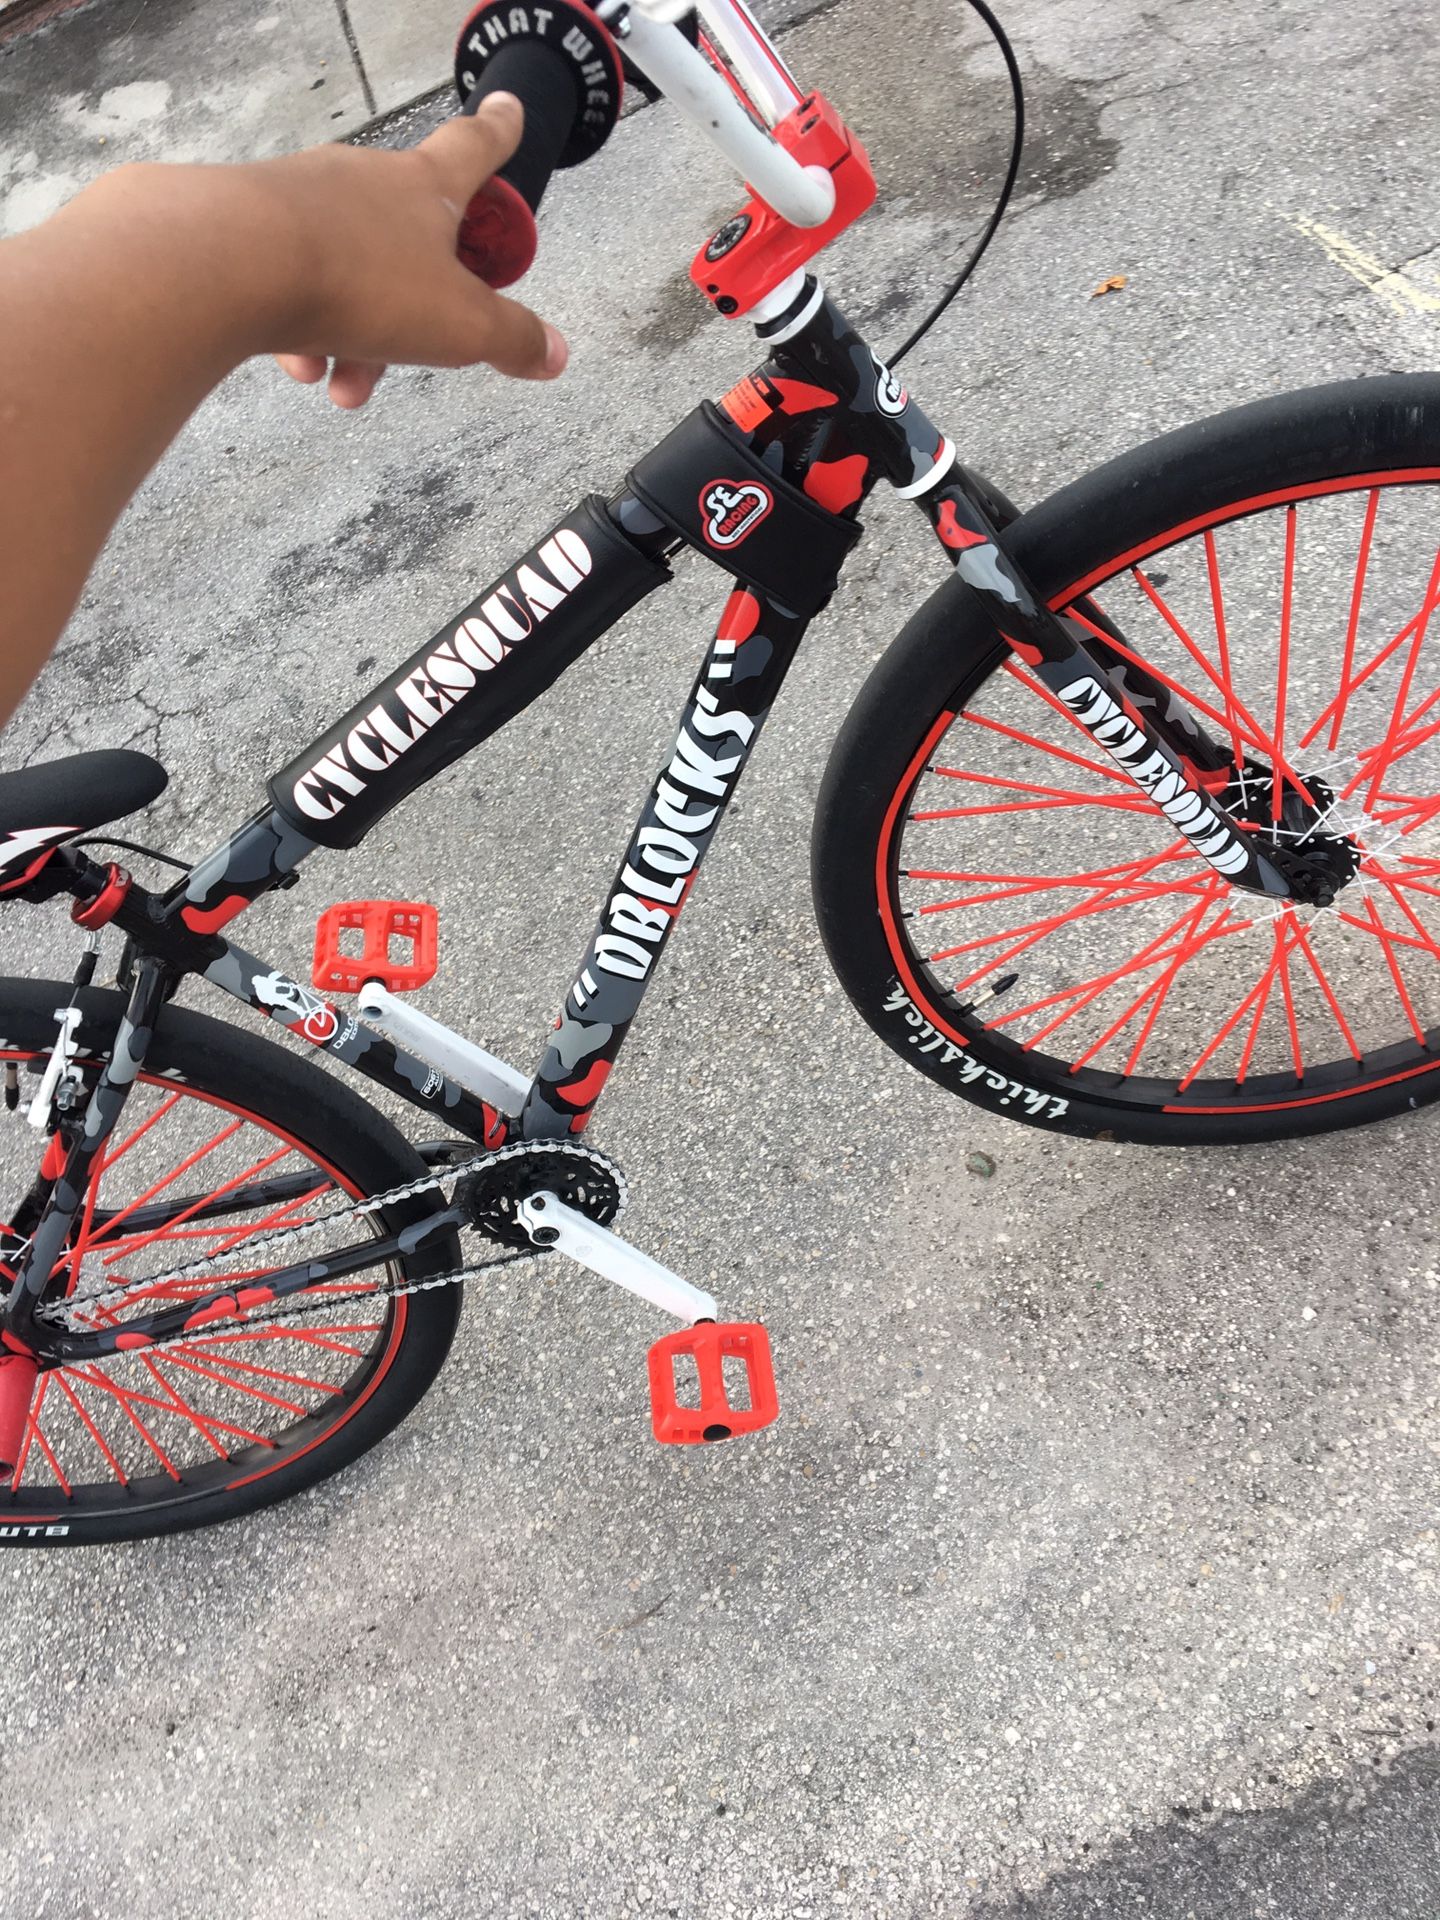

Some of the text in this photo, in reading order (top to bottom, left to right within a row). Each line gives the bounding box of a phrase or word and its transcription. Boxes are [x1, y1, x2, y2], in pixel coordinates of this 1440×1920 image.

[468, 7, 553, 58] THAT
[706, 485, 745, 524] SE
[718, 495, 758, 535] RACING
[293, 528, 592, 820] CYCLESQUAD
[332, 1017, 354, 1049] DBLO
